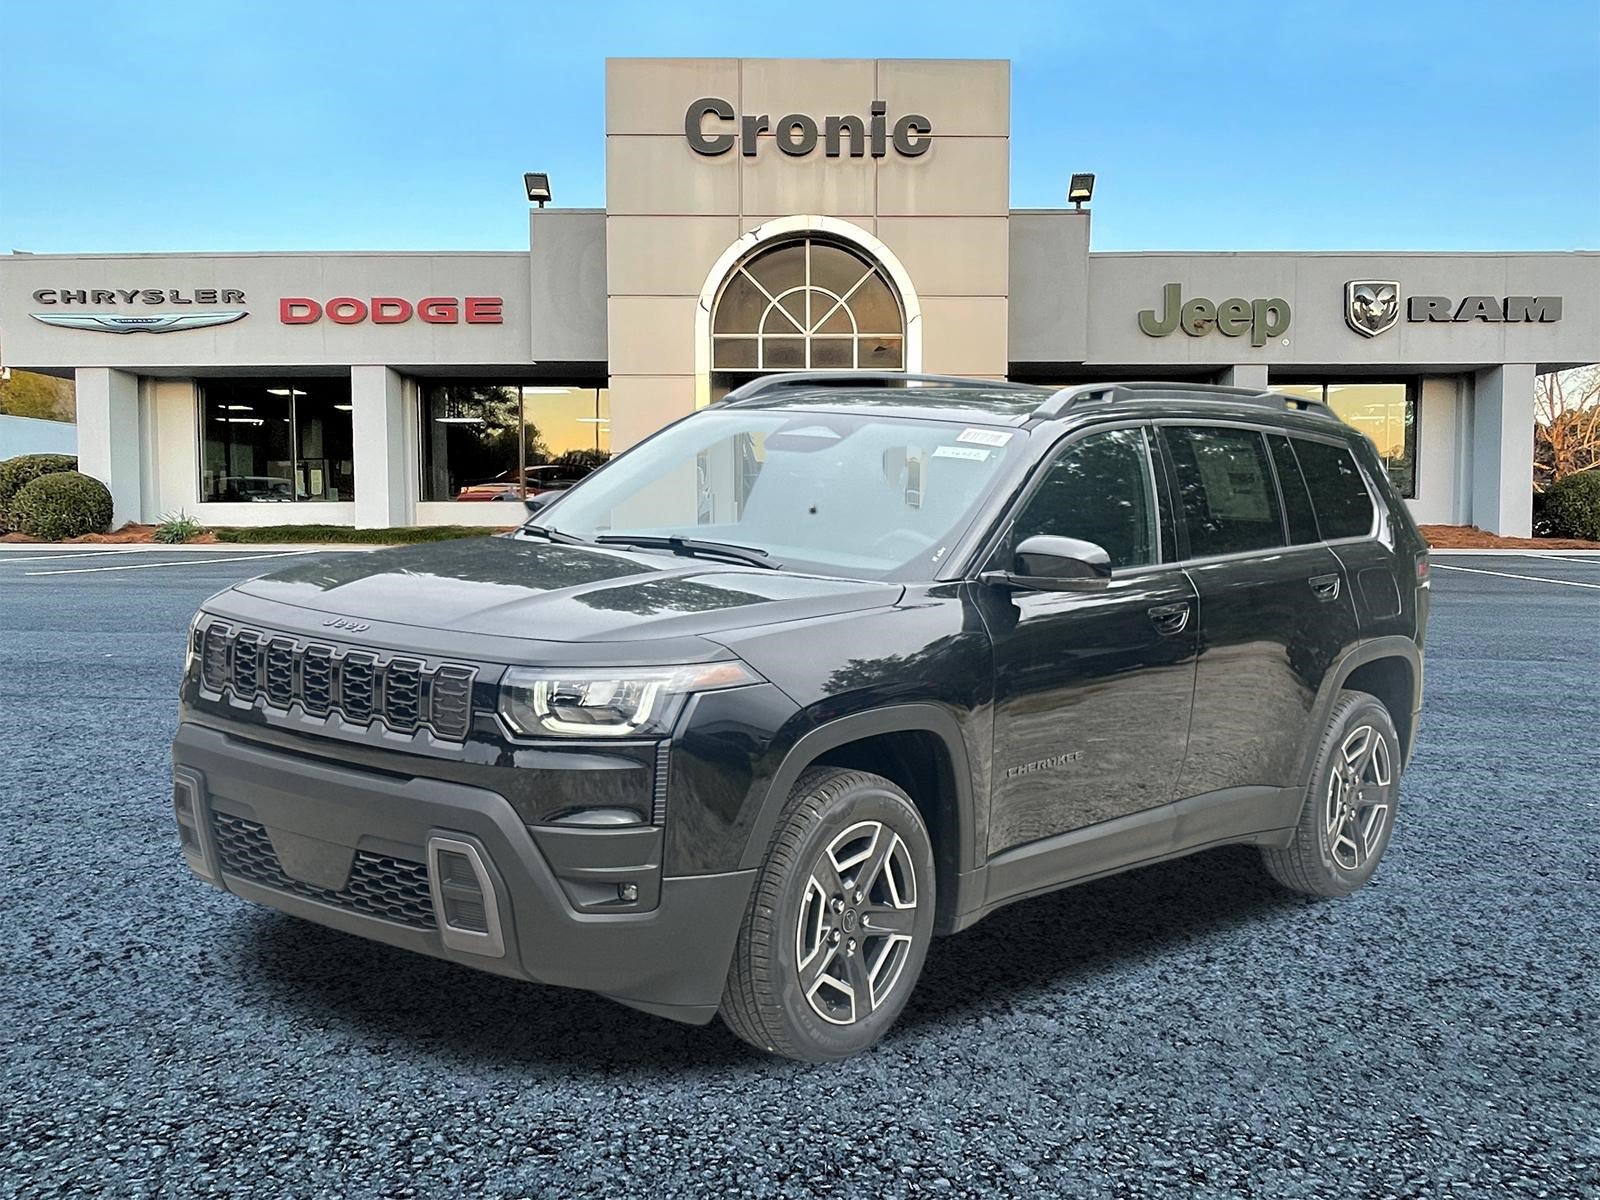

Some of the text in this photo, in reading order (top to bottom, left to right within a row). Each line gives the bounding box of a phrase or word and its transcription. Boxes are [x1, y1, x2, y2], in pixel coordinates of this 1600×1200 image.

[685, 97, 932, 157] Cronic
[32, 288, 248, 304] CHRYSLER
[1407, 296, 1563, 322] RAM
[280, 297, 503, 324] DODGE
[1138, 283, 1292, 347] Jeep
[322, 618, 371, 633] Jeep
